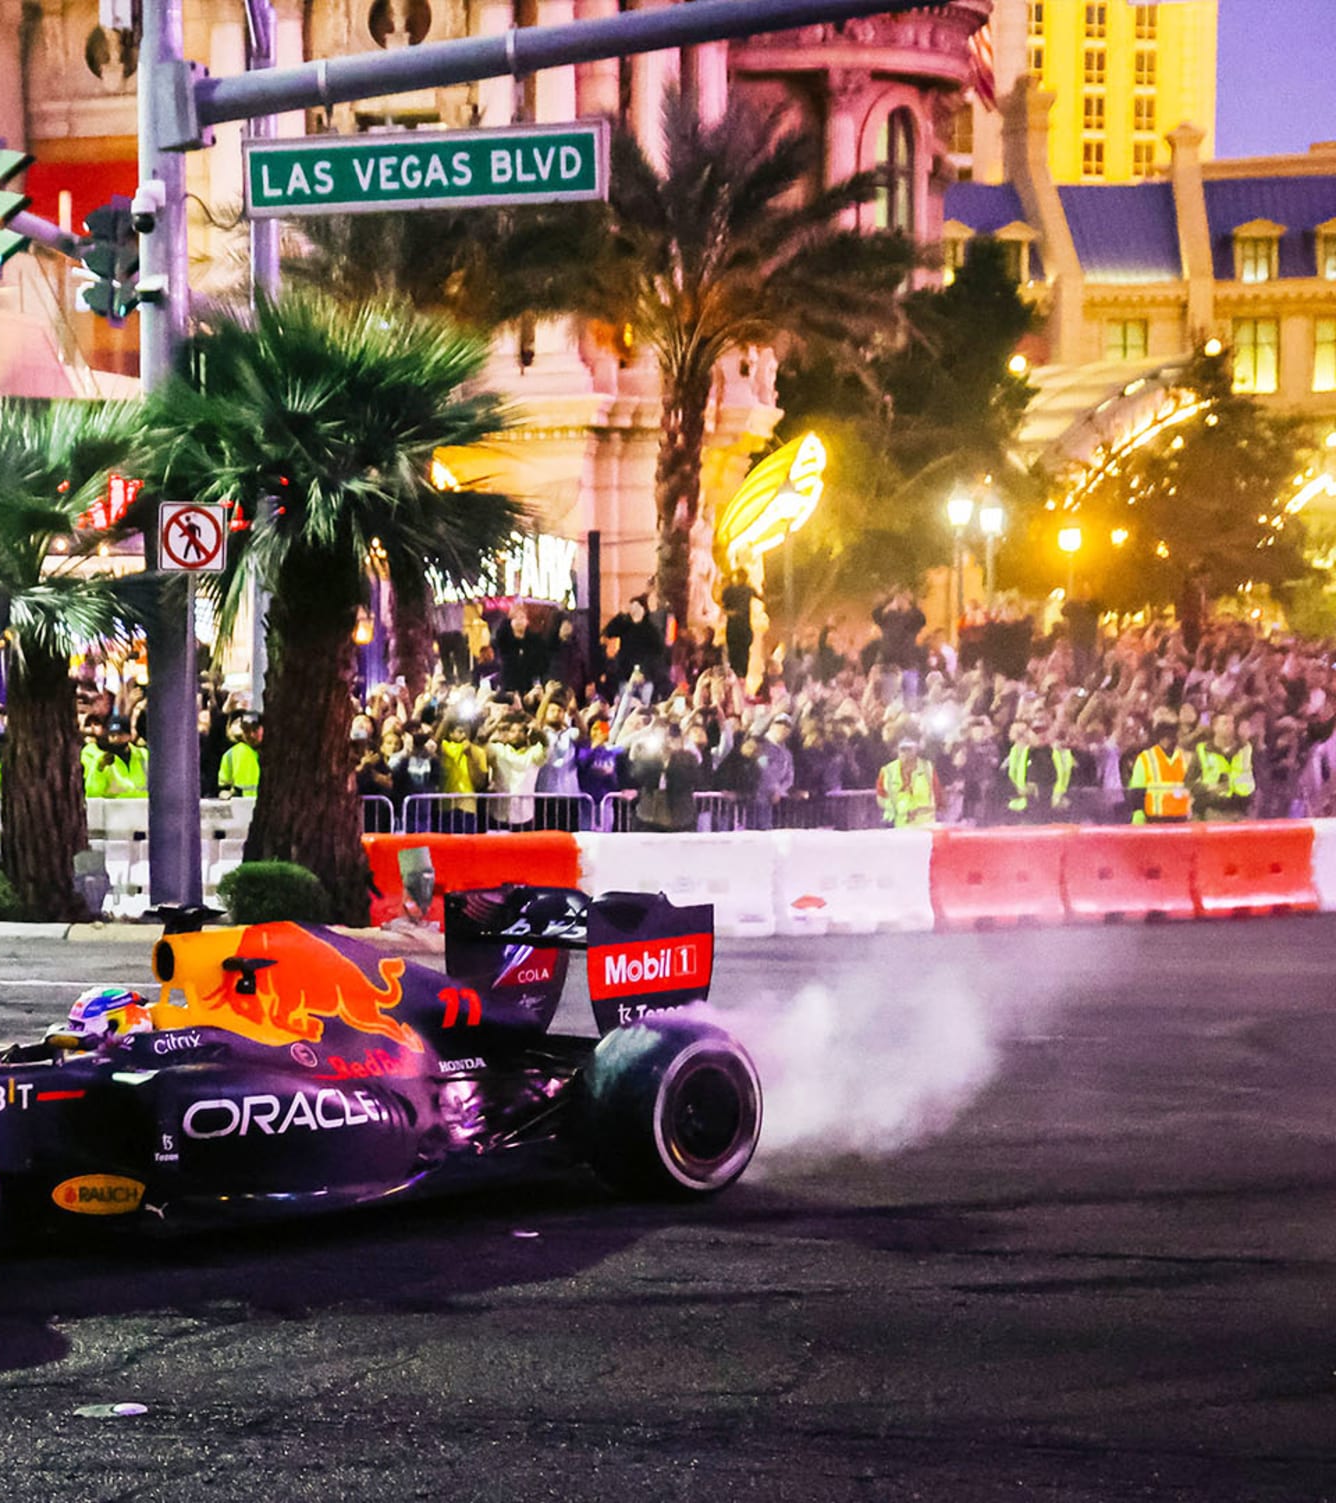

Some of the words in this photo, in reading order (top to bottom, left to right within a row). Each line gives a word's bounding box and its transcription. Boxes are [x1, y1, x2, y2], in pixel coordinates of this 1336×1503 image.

[262, 161, 334, 198] LAS
[353, 152, 472, 192] VEGAS
[490, 146, 582, 184] BLVD
[517, 968, 550, 983] COLA
[604, 948, 671, 985] Mobil
[437, 987, 482, 1029] 11
[438, 1056, 487, 1073] HONDA
[182, 1088, 389, 1139] ORACLE
[79, 1186, 139, 1203] RAUCH
